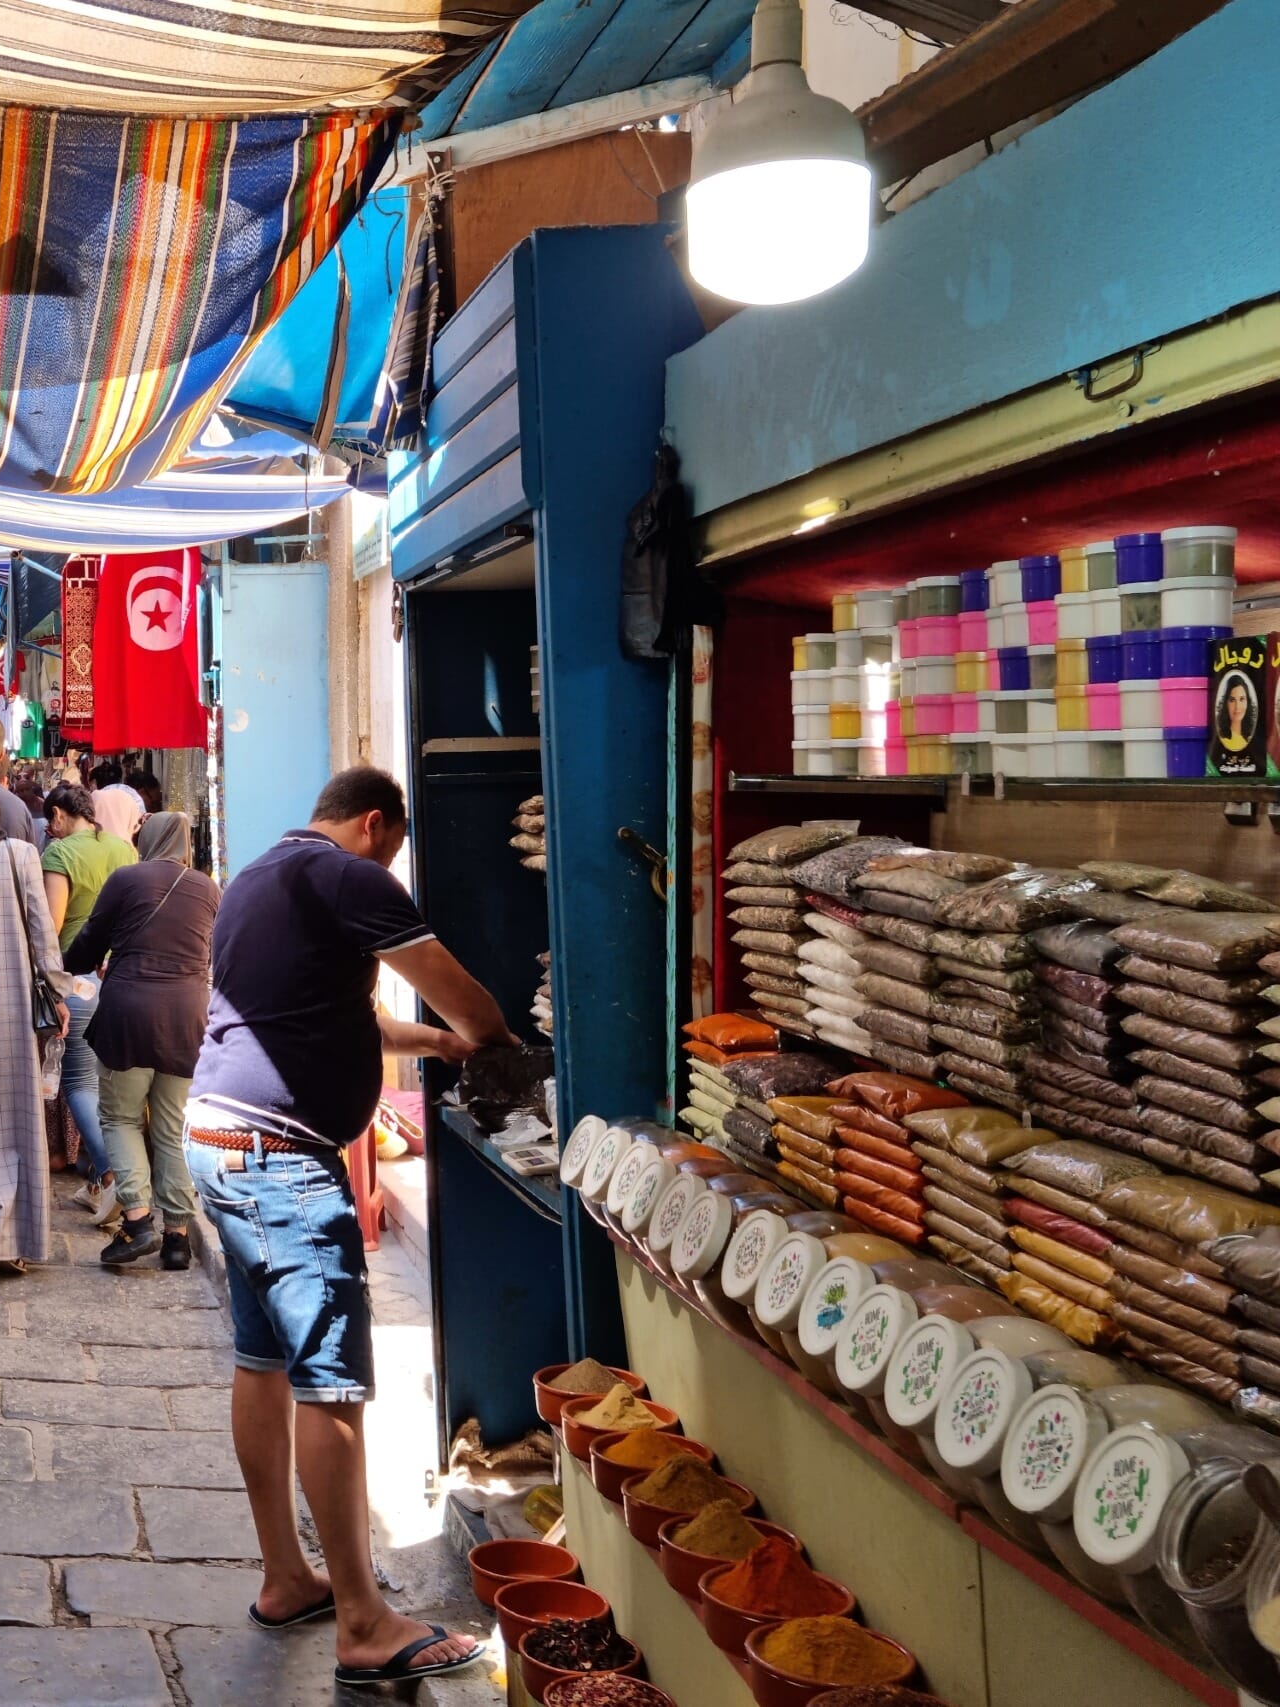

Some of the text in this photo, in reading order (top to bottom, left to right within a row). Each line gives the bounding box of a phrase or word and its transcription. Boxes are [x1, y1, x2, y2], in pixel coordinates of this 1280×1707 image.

[1214, 645, 1264, 672] رويال
[1114, 1456, 1137, 1478] HOME
[1111, 1499, 1134, 1520] HOME
